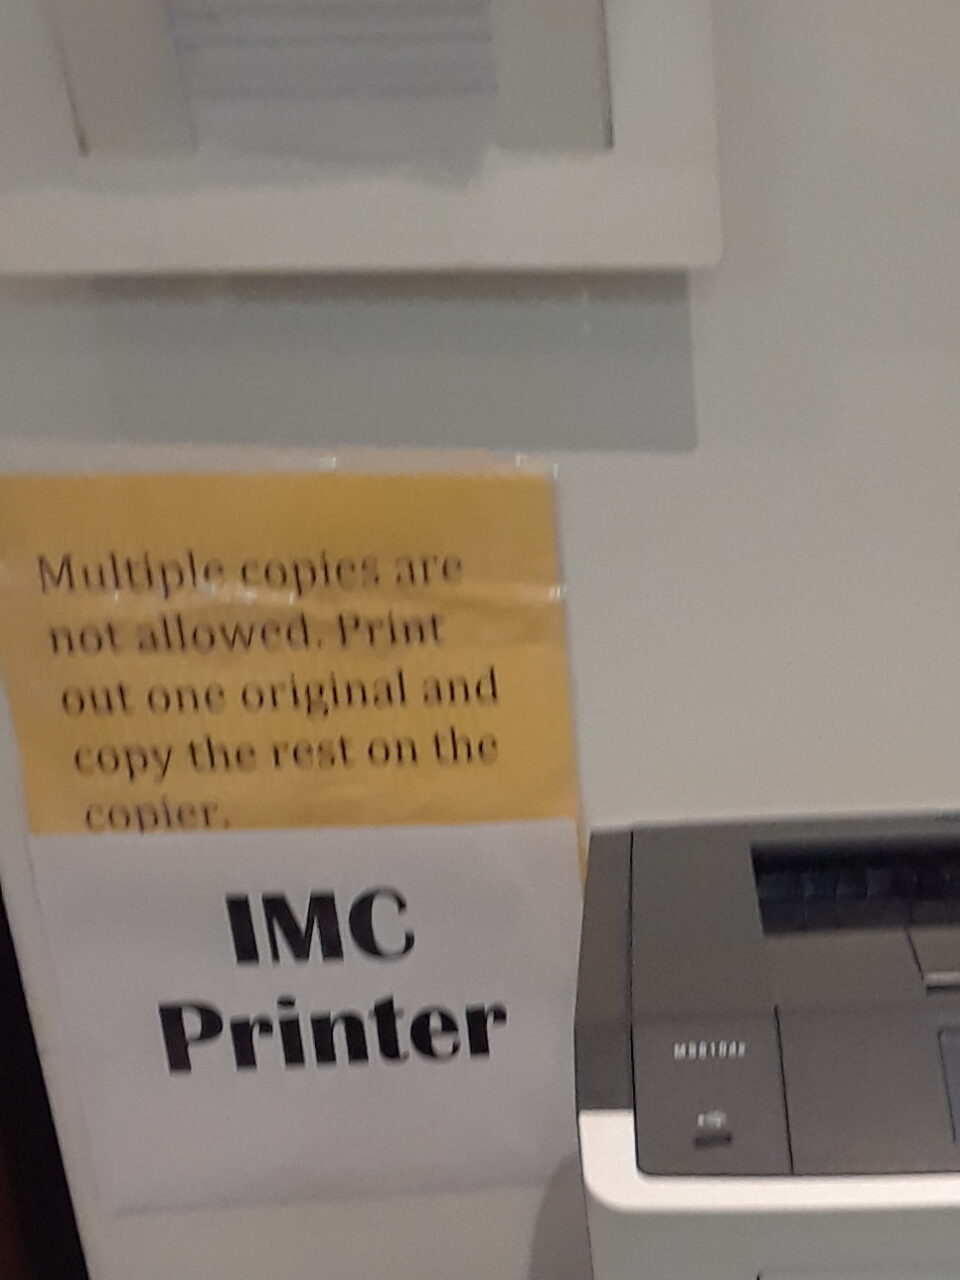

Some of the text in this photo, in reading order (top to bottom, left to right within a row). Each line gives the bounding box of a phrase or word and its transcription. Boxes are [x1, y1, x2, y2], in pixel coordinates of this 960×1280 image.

[37, 550, 464, 600] Multiple copies are
[49, 609, 445, 657] not allowed. Print
[61, 665, 498, 719] out one original and
[74, 725, 498, 783] copy the rest on the
[84, 793, 231, 834] copier.
[225, 885, 415, 966] IMC
[158, 995, 507, 1076] Printer
